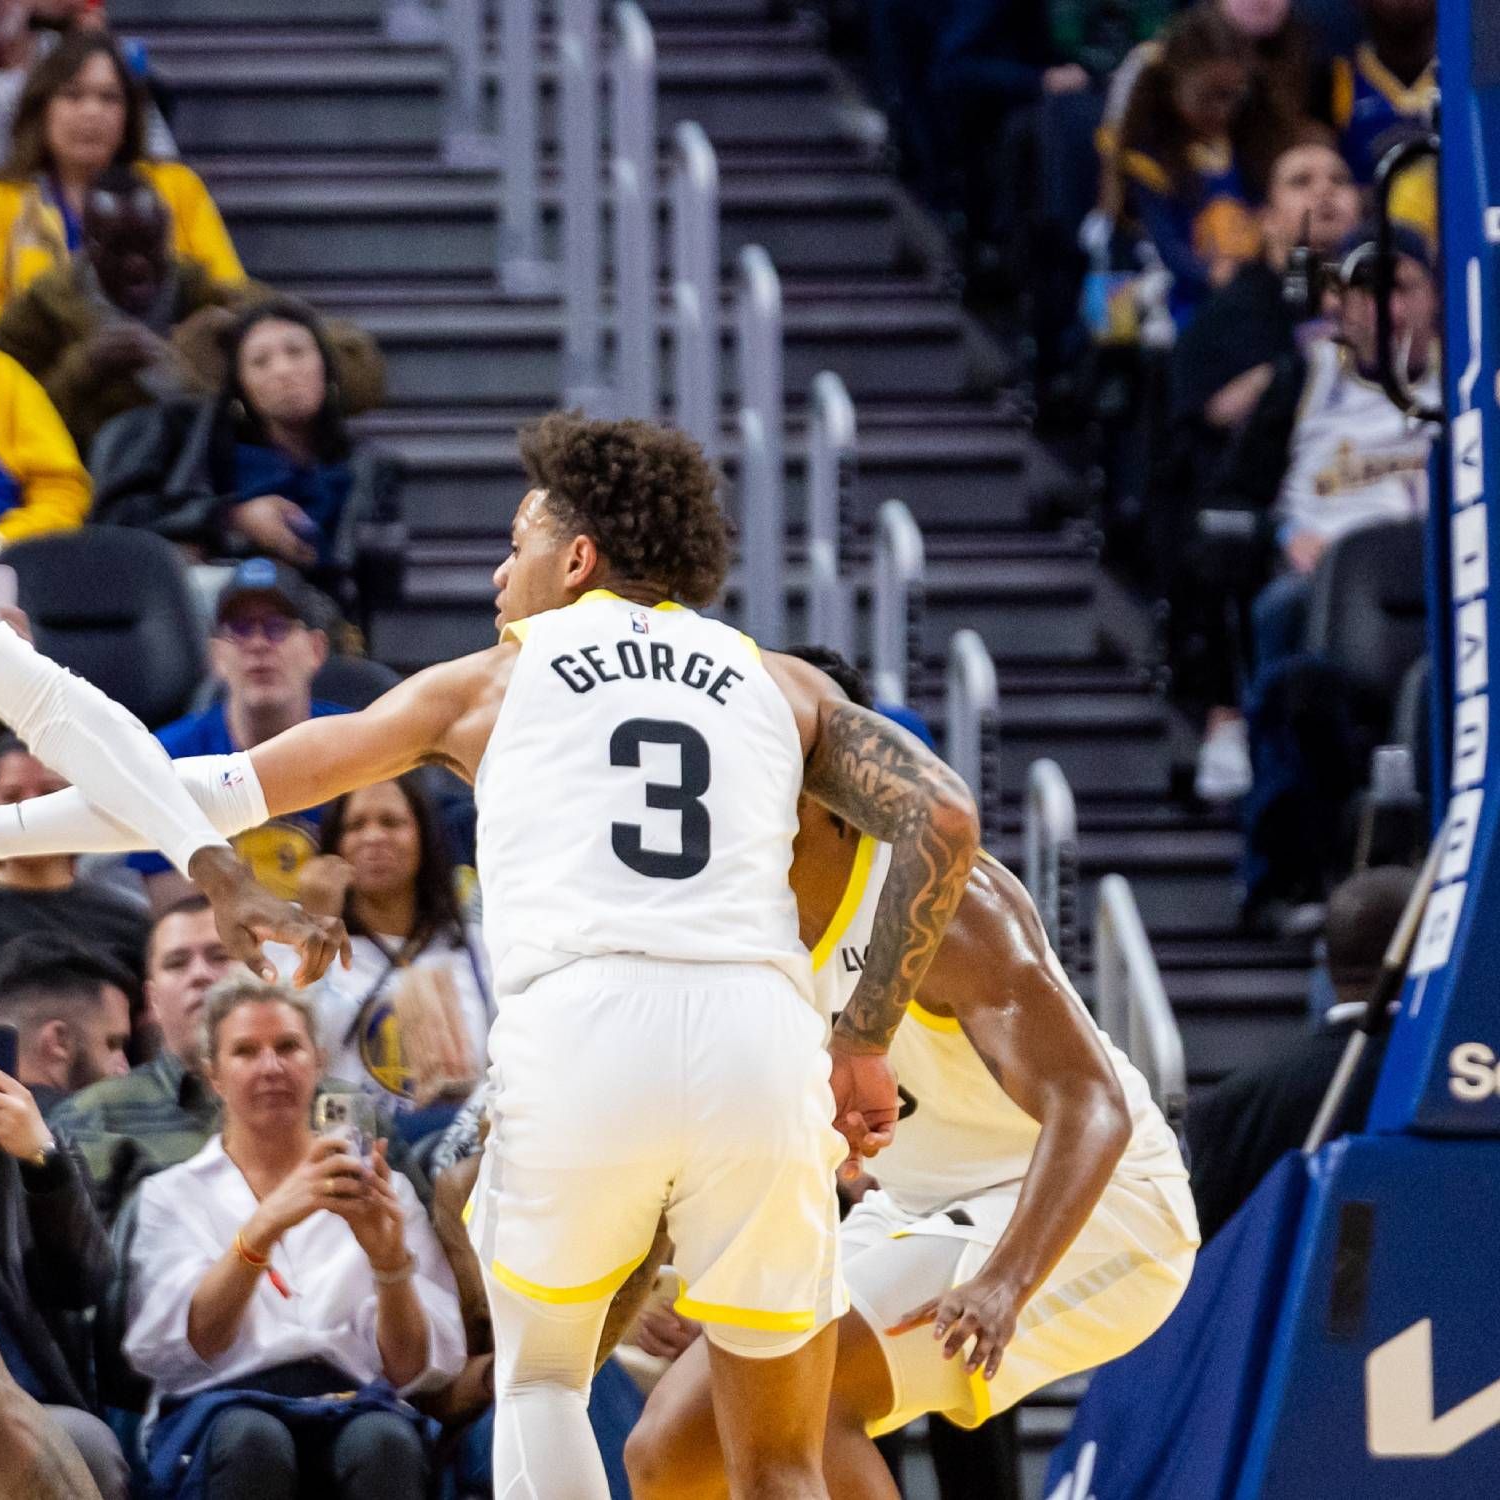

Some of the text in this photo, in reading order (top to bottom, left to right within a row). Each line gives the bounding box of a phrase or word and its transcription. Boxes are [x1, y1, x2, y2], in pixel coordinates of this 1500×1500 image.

[550, 640, 745, 705] GEORGE
[609, 717, 712, 880] 3
[1448, 1041, 1500, 1101] S
